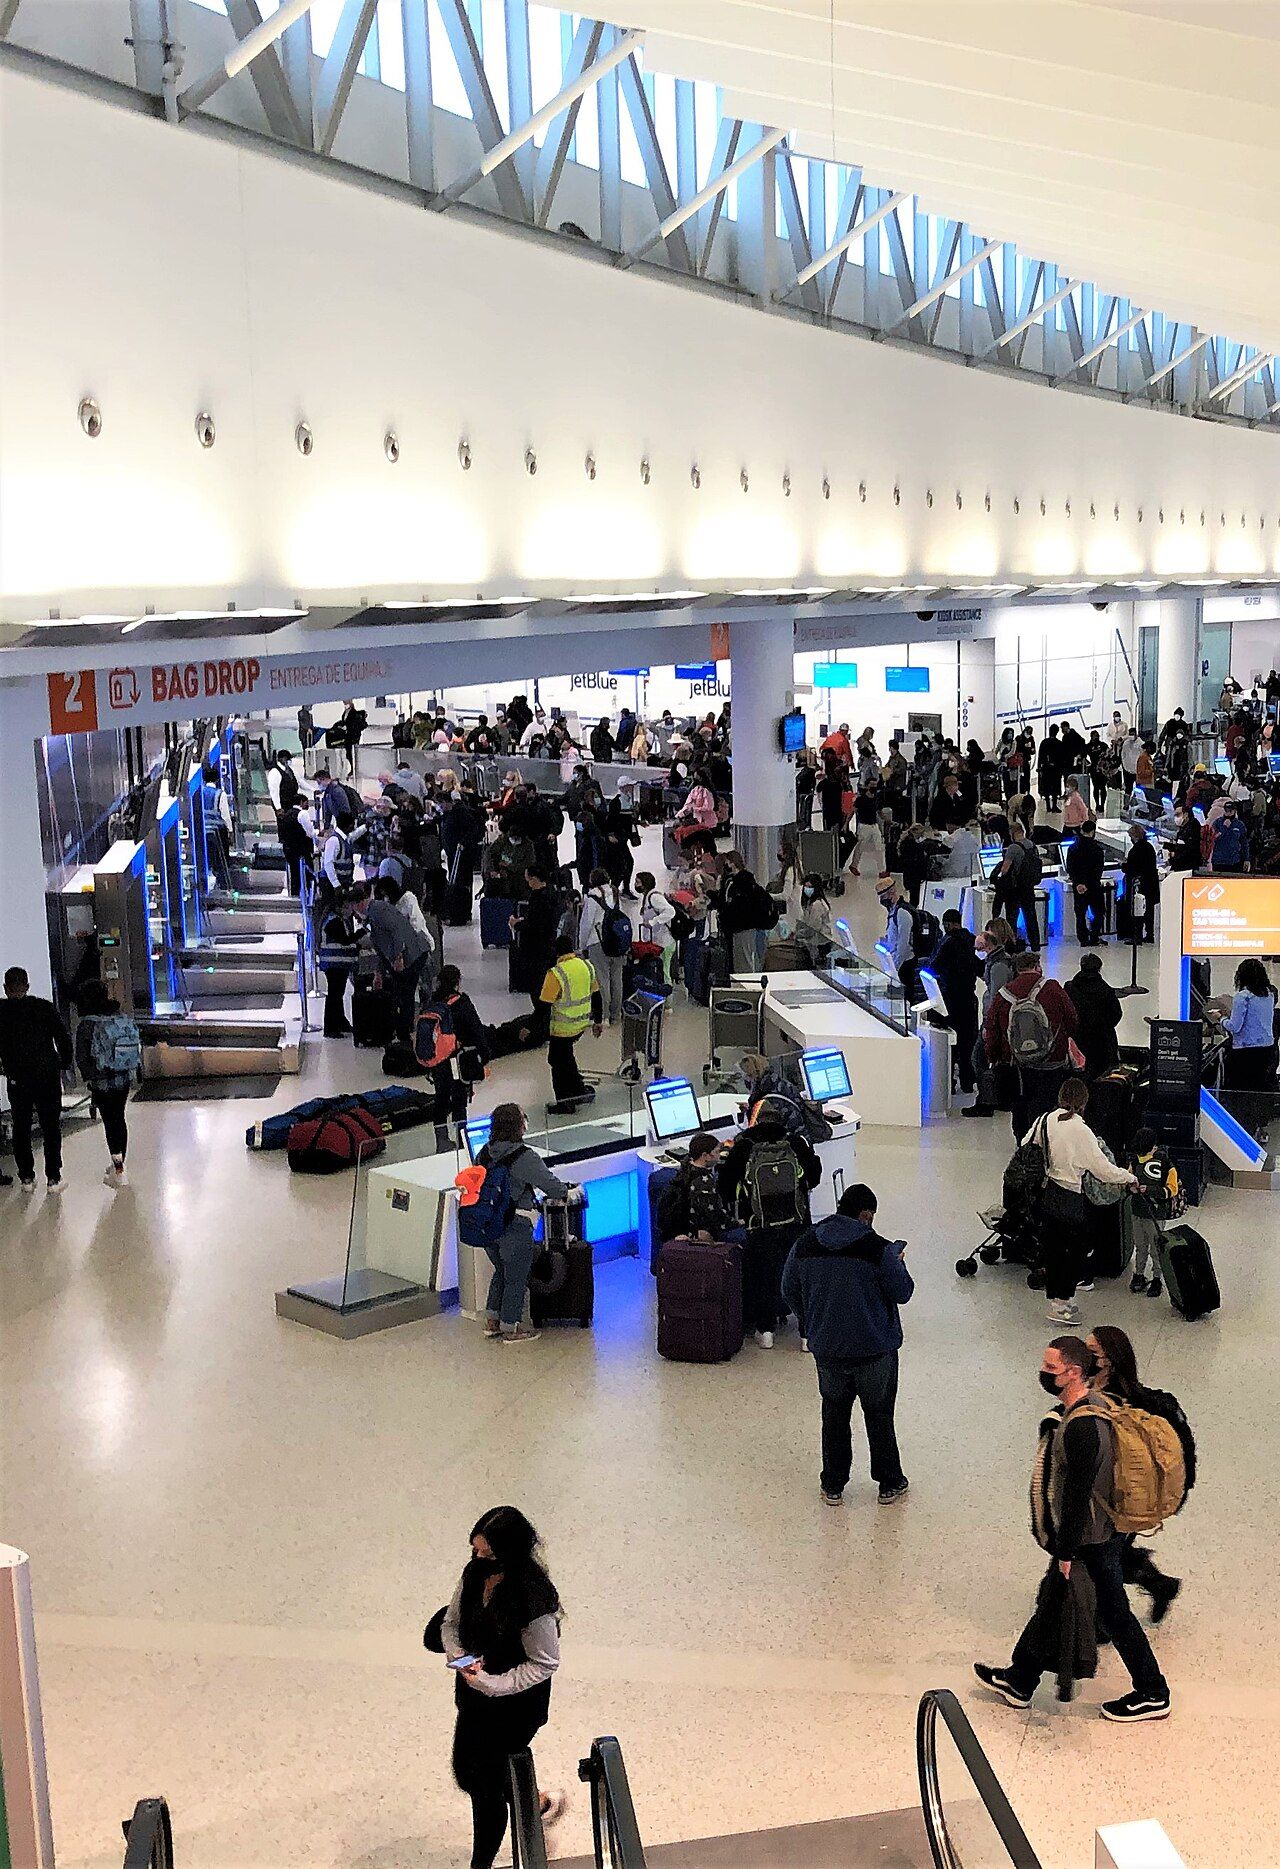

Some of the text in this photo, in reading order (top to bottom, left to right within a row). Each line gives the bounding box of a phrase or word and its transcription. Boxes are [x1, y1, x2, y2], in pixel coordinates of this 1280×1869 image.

[953, 608, 982, 621] ASSISTANCE
[152, 658, 261, 702] BAG DROP
[269, 664, 323, 690] ENTREGA
[325, 662, 342, 684] DE
[570, 672, 618, 692] jetBlue
[63, 671, 84, 713] 2
[689, 679, 731, 699] jetBlu
[1143, 1161, 1162, 1179] G
